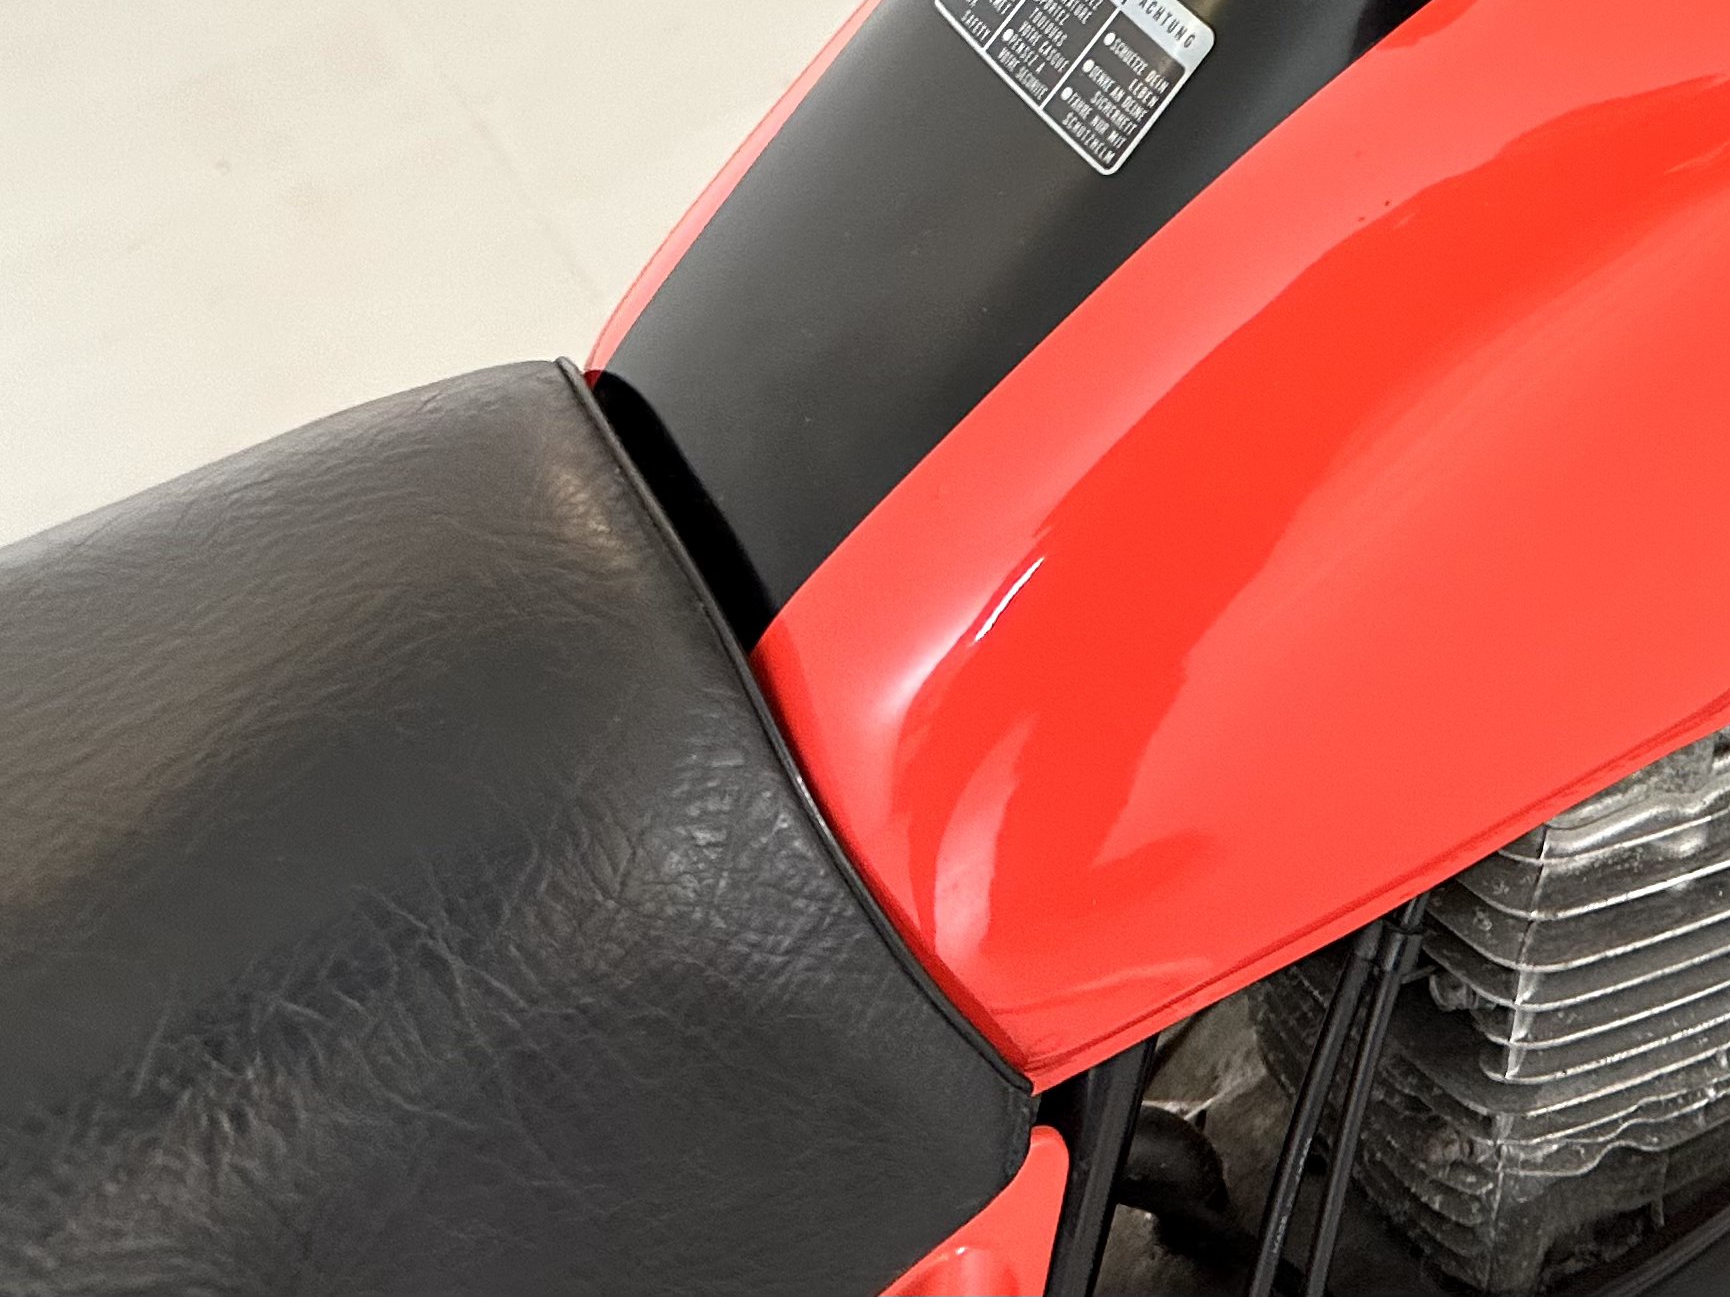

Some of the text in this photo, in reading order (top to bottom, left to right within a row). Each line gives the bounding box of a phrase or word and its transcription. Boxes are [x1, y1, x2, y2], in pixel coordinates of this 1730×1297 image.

[959, 8, 991, 43] SAFETY
[1016, 19, 1070, 74] VOTRE CASQUE
[1026, 5, 1068, 48] TOUJOURS
[1006, 32, 1039, 68] PENSEZ
[1108, 36, 1170, 95] SCHUETZE DEIN
[1089, 88, 1138, 139] SICHERHEIT
[1108, 82, 1126, 104] AN
[1119, 93, 1148, 124] DEINE
[1126, 76, 1159, 111] LEBEN
[1060, 109, 1115, 168] SCHUTZHELM
[1066, 91, 1126, 152] FAHRE NUR MIT
